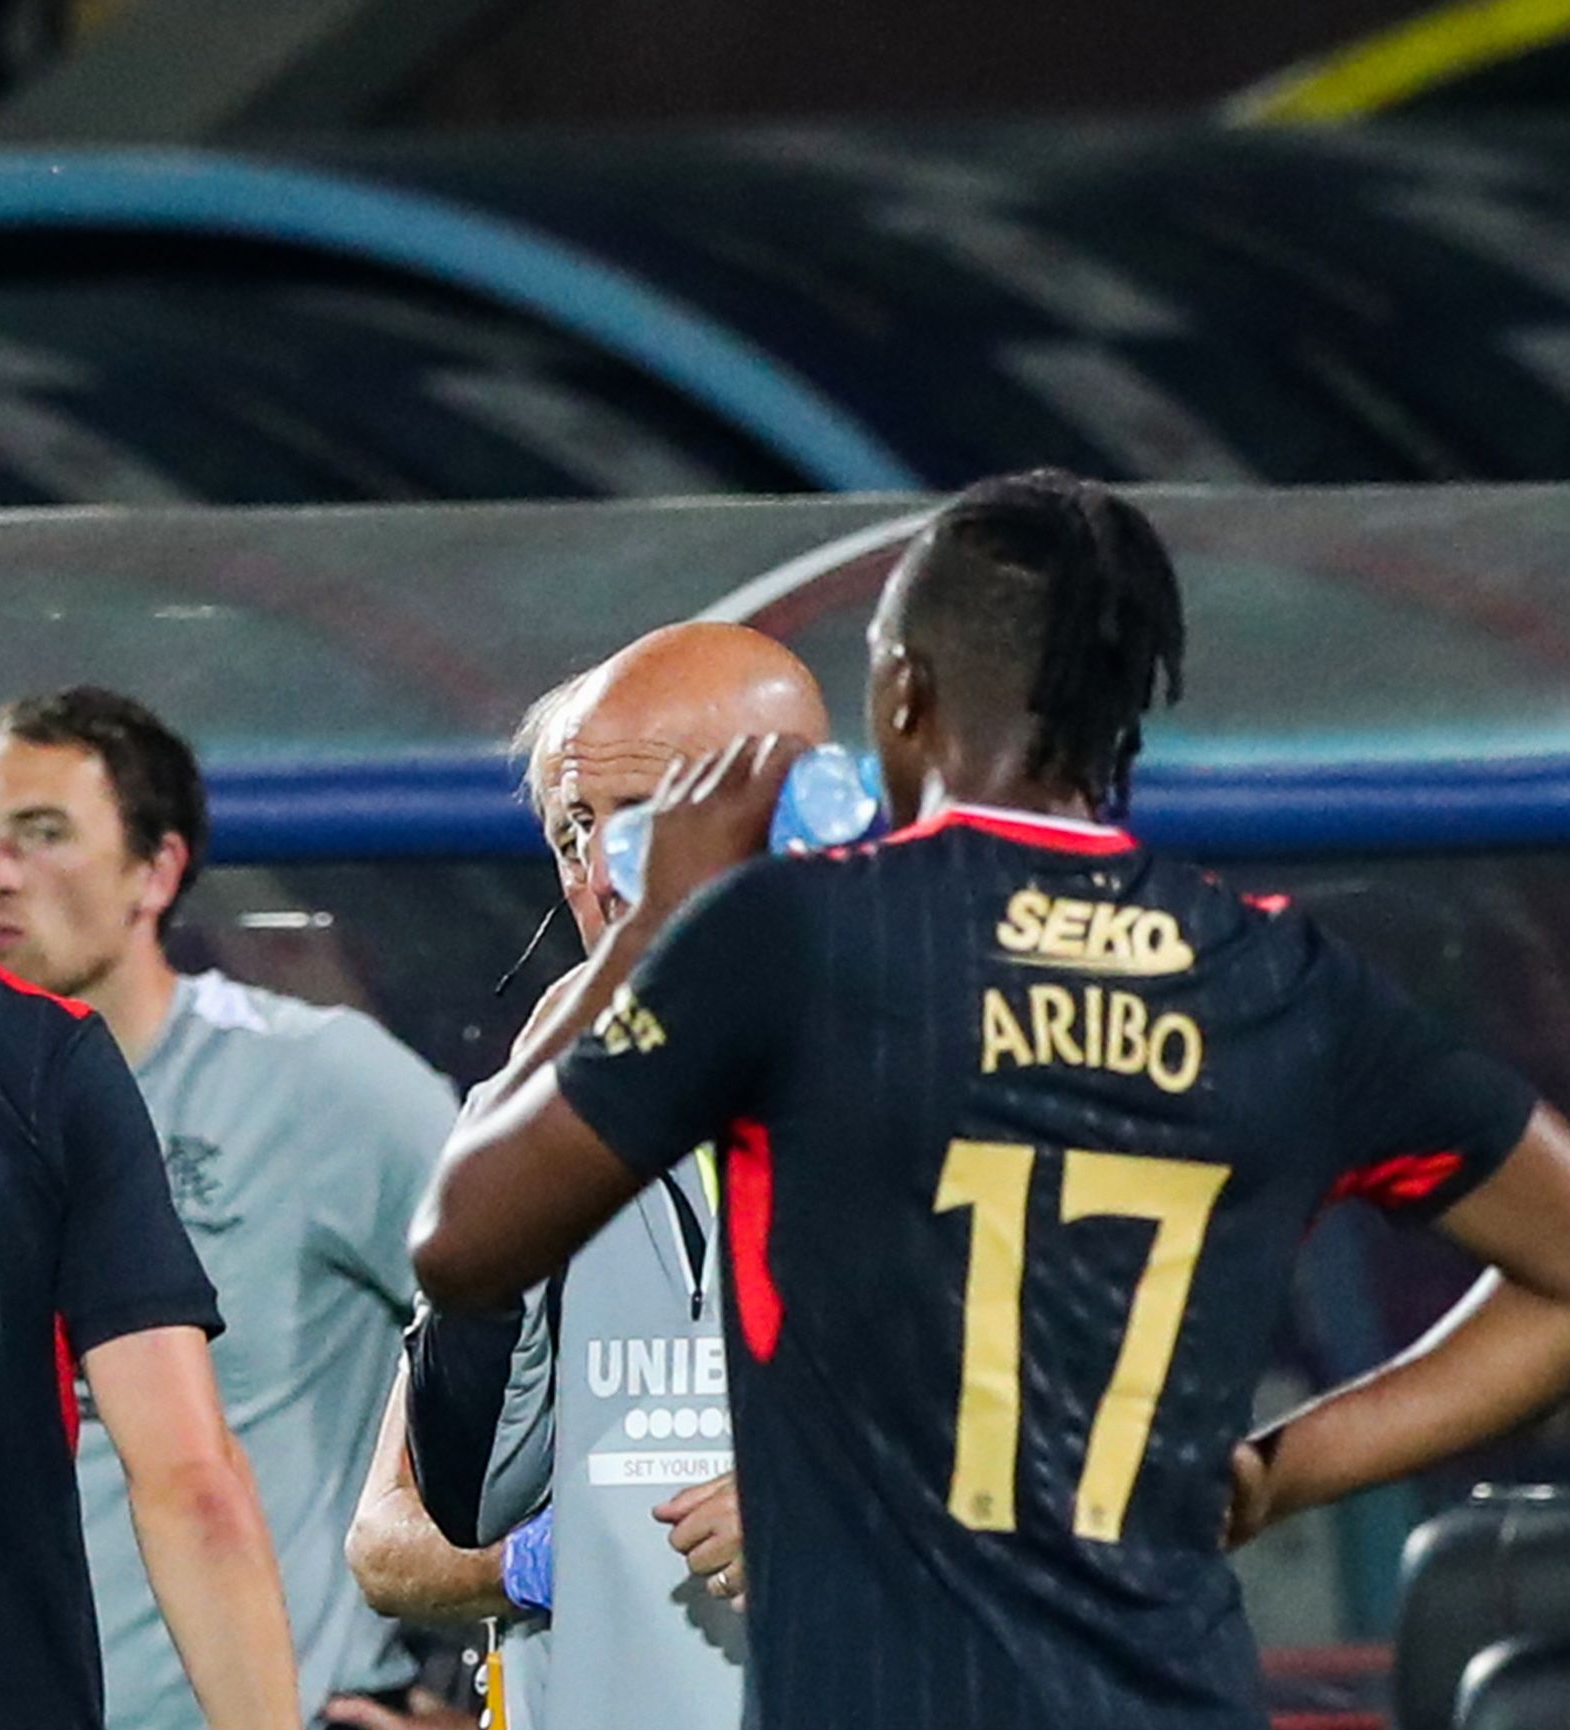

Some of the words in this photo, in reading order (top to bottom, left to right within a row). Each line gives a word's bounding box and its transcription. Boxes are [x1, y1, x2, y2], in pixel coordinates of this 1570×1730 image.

[996, 890, 1195, 977] SEKO
[980, 984, 1202, 1094] ARIBO
[933, 1138, 1233, 1544] 17
[624, 1459, 655, 1477] SET
[660, 1458, 709, 1476] YOUR
